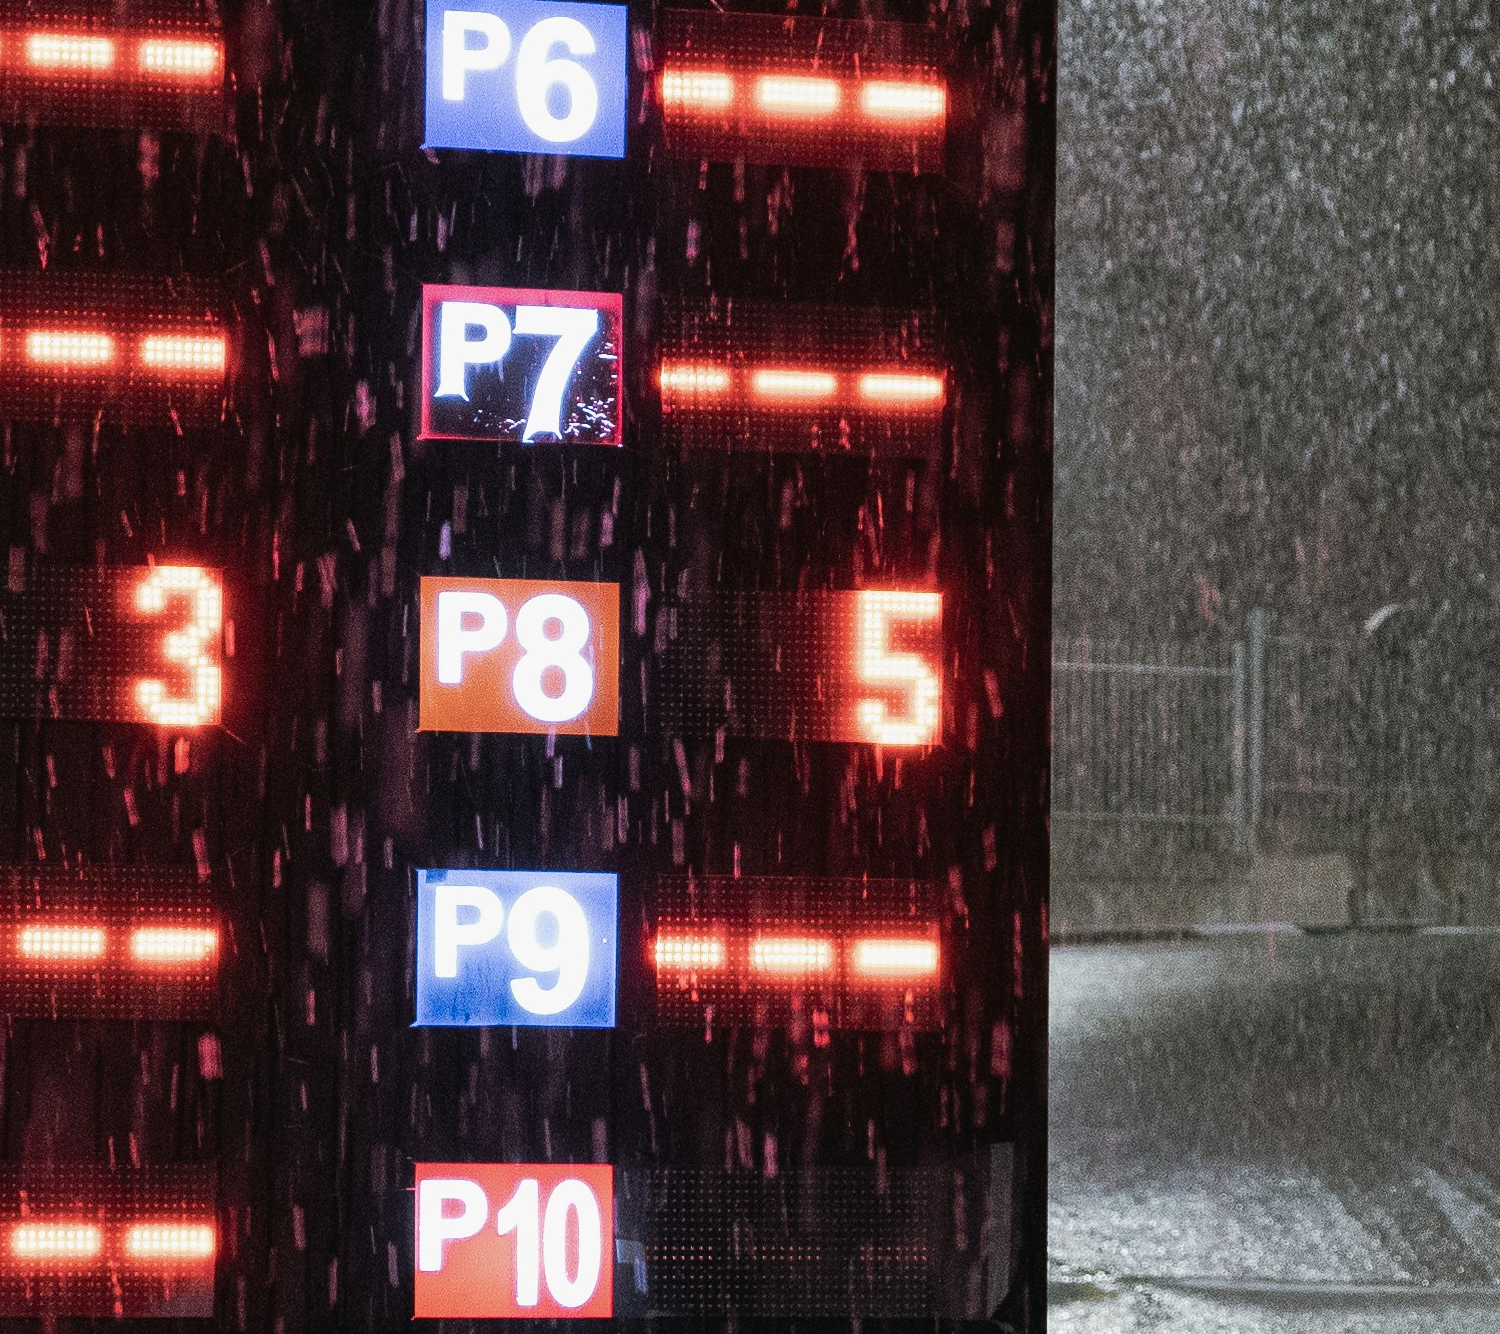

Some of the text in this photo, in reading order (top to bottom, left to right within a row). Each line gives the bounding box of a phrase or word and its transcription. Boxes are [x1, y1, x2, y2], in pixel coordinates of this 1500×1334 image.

[443, 11, 597, 142] P6
[434, 302, 598, 443] P7
[130, 563, 225, 728] 3
[436, 591, 594, 722] P8
[853, 586, 942, 749] 5
[435, 886, 589, 1014] P9
[419, 1179, 601, 1307] P10
